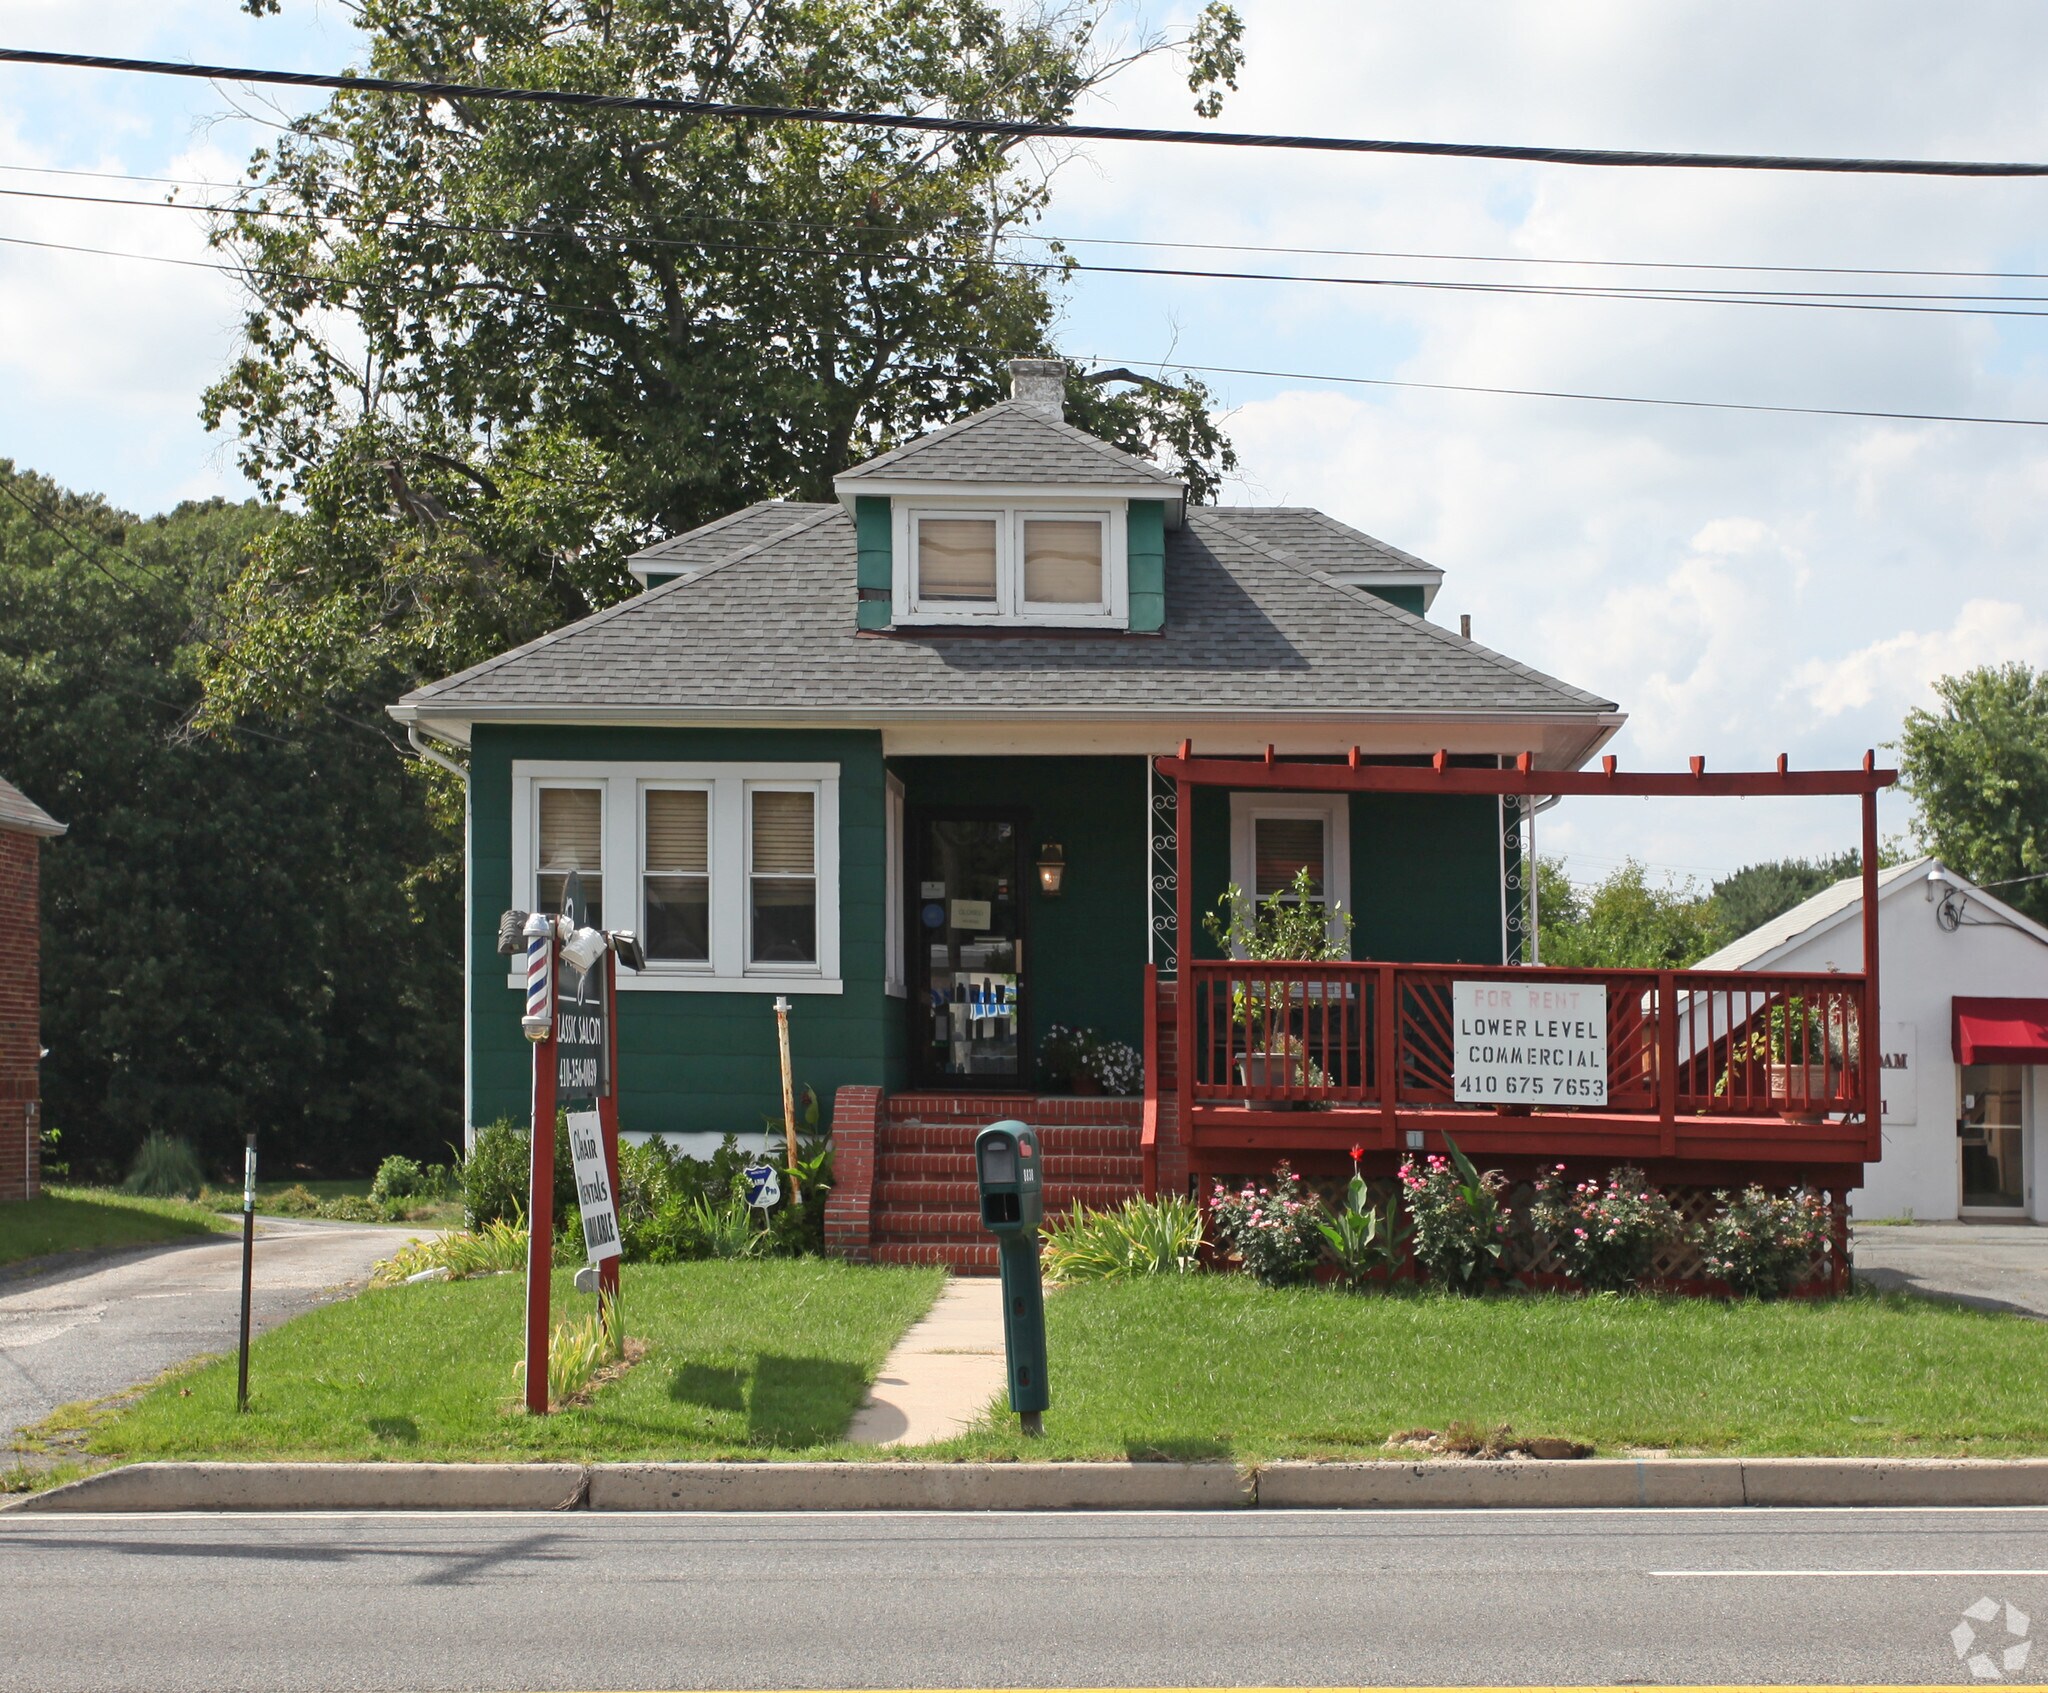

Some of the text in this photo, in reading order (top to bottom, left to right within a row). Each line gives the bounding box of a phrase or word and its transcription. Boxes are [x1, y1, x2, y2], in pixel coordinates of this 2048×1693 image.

[1474, 989, 1580, 1010] FOR RENT
[556, 1013, 601, 1045] LASSIC SALON
[1461, 1018, 1598, 1039] LOWER LEVEL
[1469, 1045, 1600, 1068] COMMERCIAL
[1460, 1076, 1604, 1097] 410 675 7653
